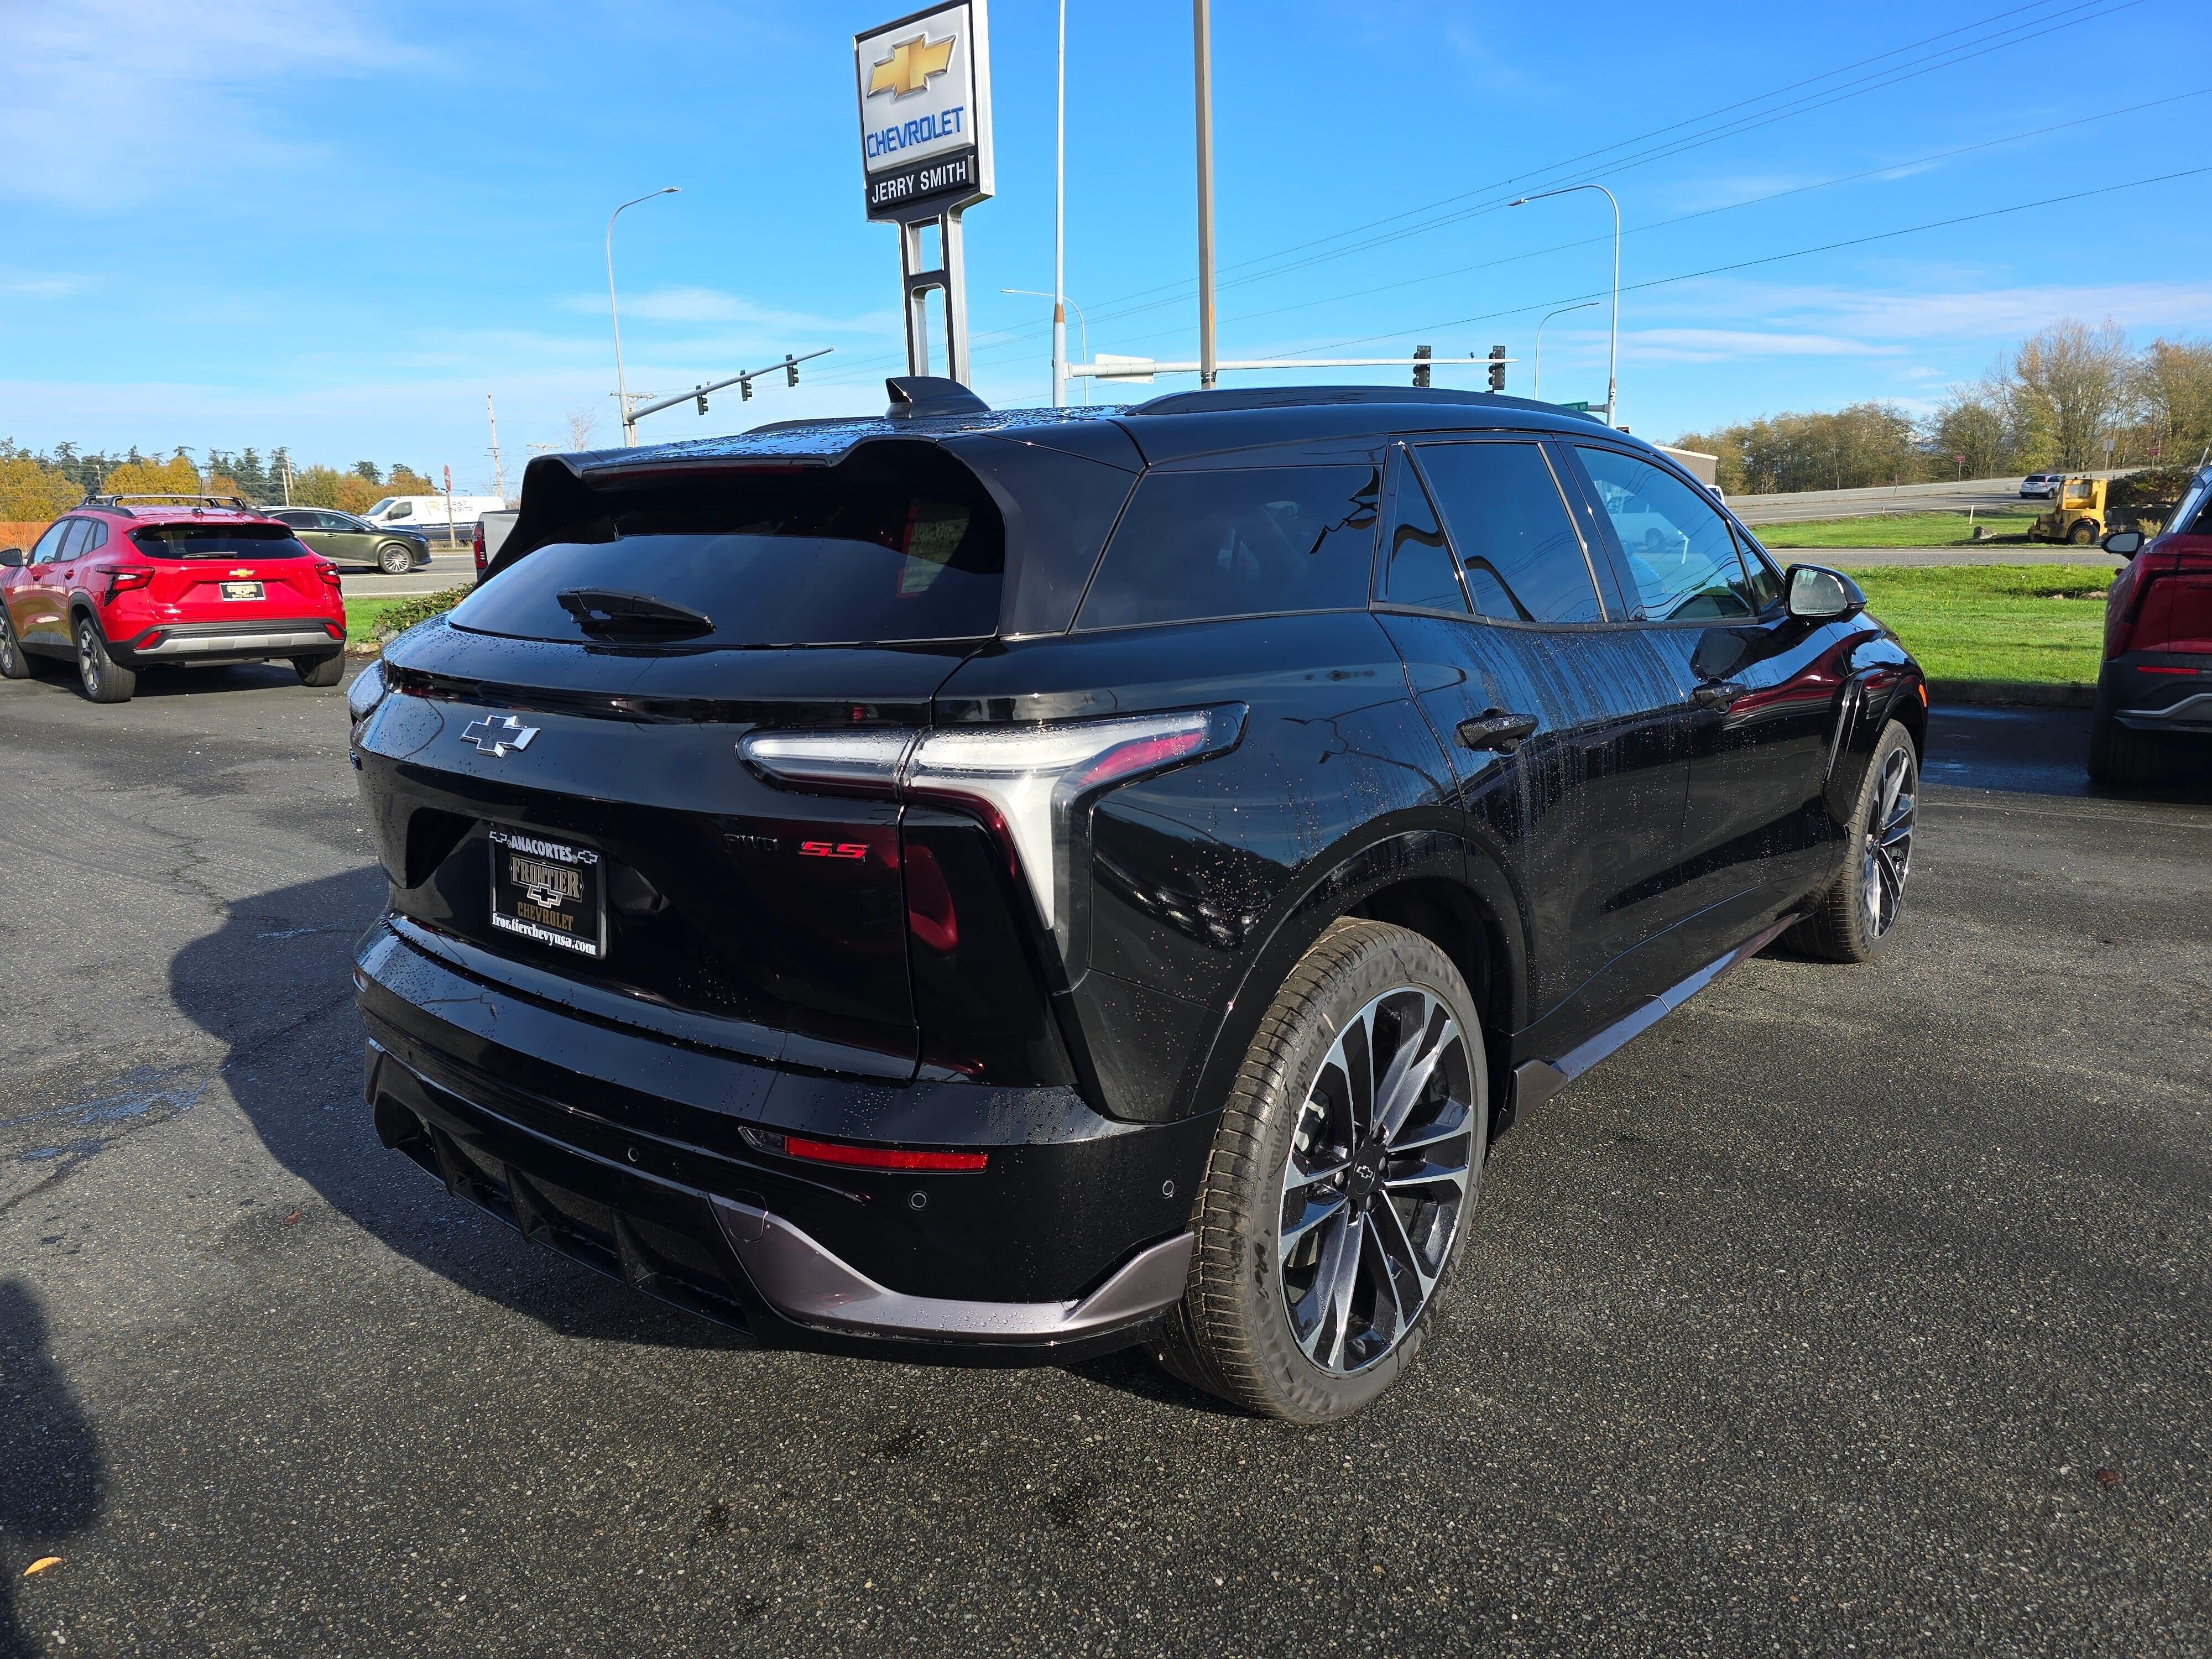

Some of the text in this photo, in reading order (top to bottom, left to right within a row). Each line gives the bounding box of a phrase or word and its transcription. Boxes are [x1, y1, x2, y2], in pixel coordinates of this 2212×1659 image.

[867, 106, 964, 158] CHEVROLET
[872, 160, 966, 204] JERRY SMITH
[511, 836, 573, 862] ANACORTES
[799, 841, 870, 858] SS
[512, 857, 580, 899] FRONTIER
[492, 912, 597, 956] frontierchevyusa.com
[517, 901, 573, 931] CHEVROLET
[1260, 1038, 1319, 1204] PremiumContact
